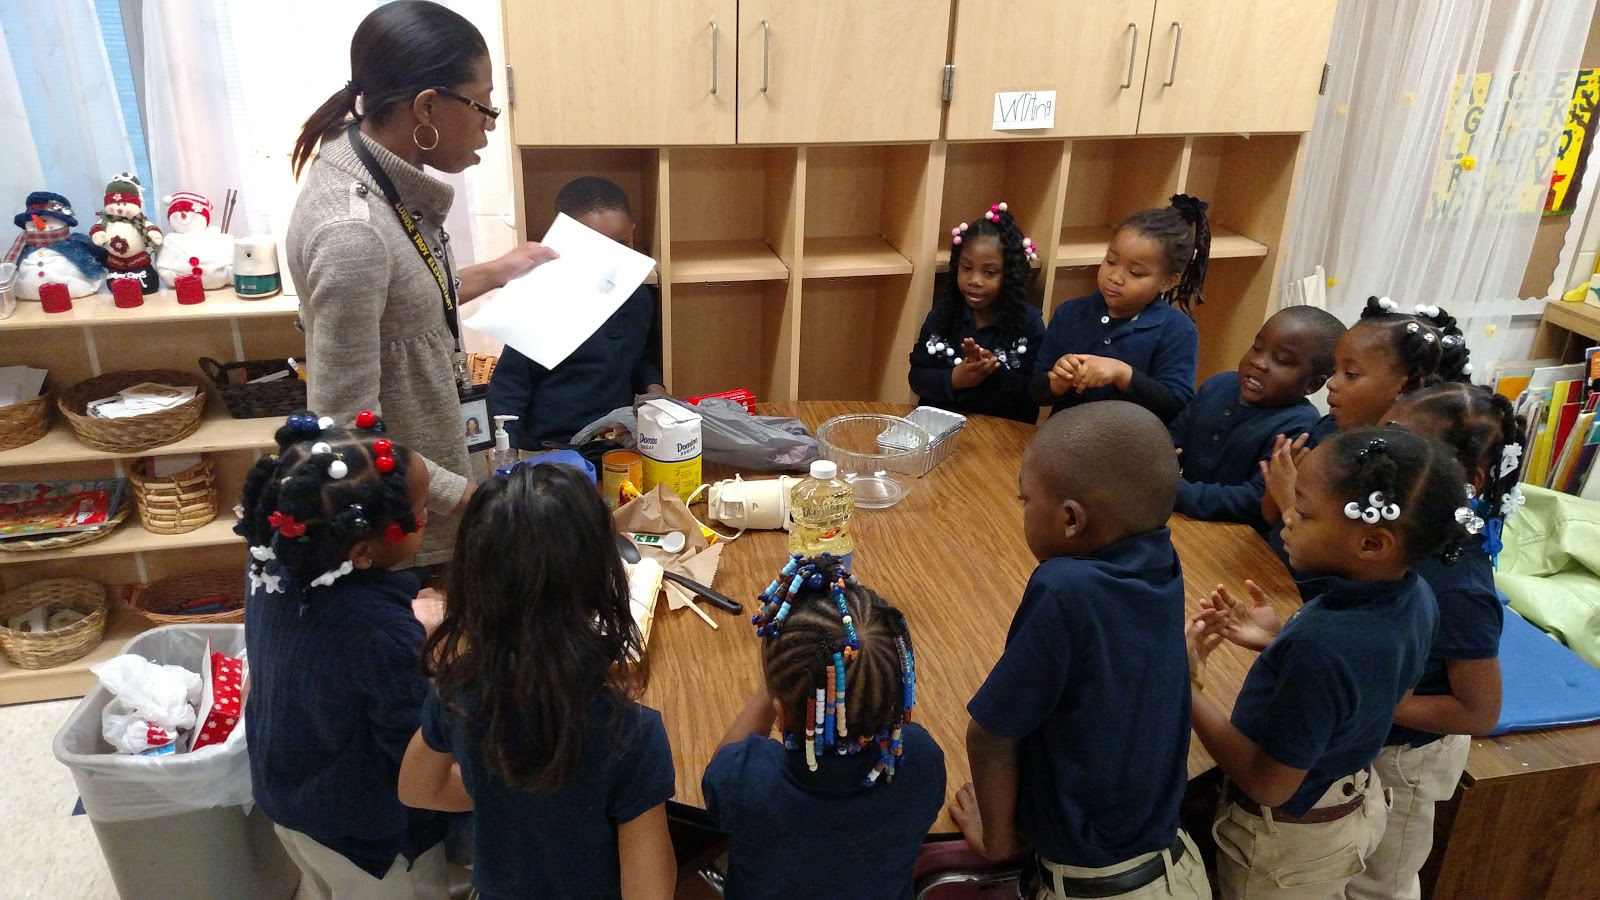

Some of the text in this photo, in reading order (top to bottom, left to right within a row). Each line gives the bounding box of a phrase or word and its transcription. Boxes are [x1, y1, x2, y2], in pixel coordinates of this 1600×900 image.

[1571, 69, 1595, 101] F
[1463, 106, 1485, 135] G
[1550, 129, 1573, 161] Q
[395, 202, 416, 233] LOUISE
[413, 233, 430, 257] TROY
[676, 437, 699, 453] Domino
